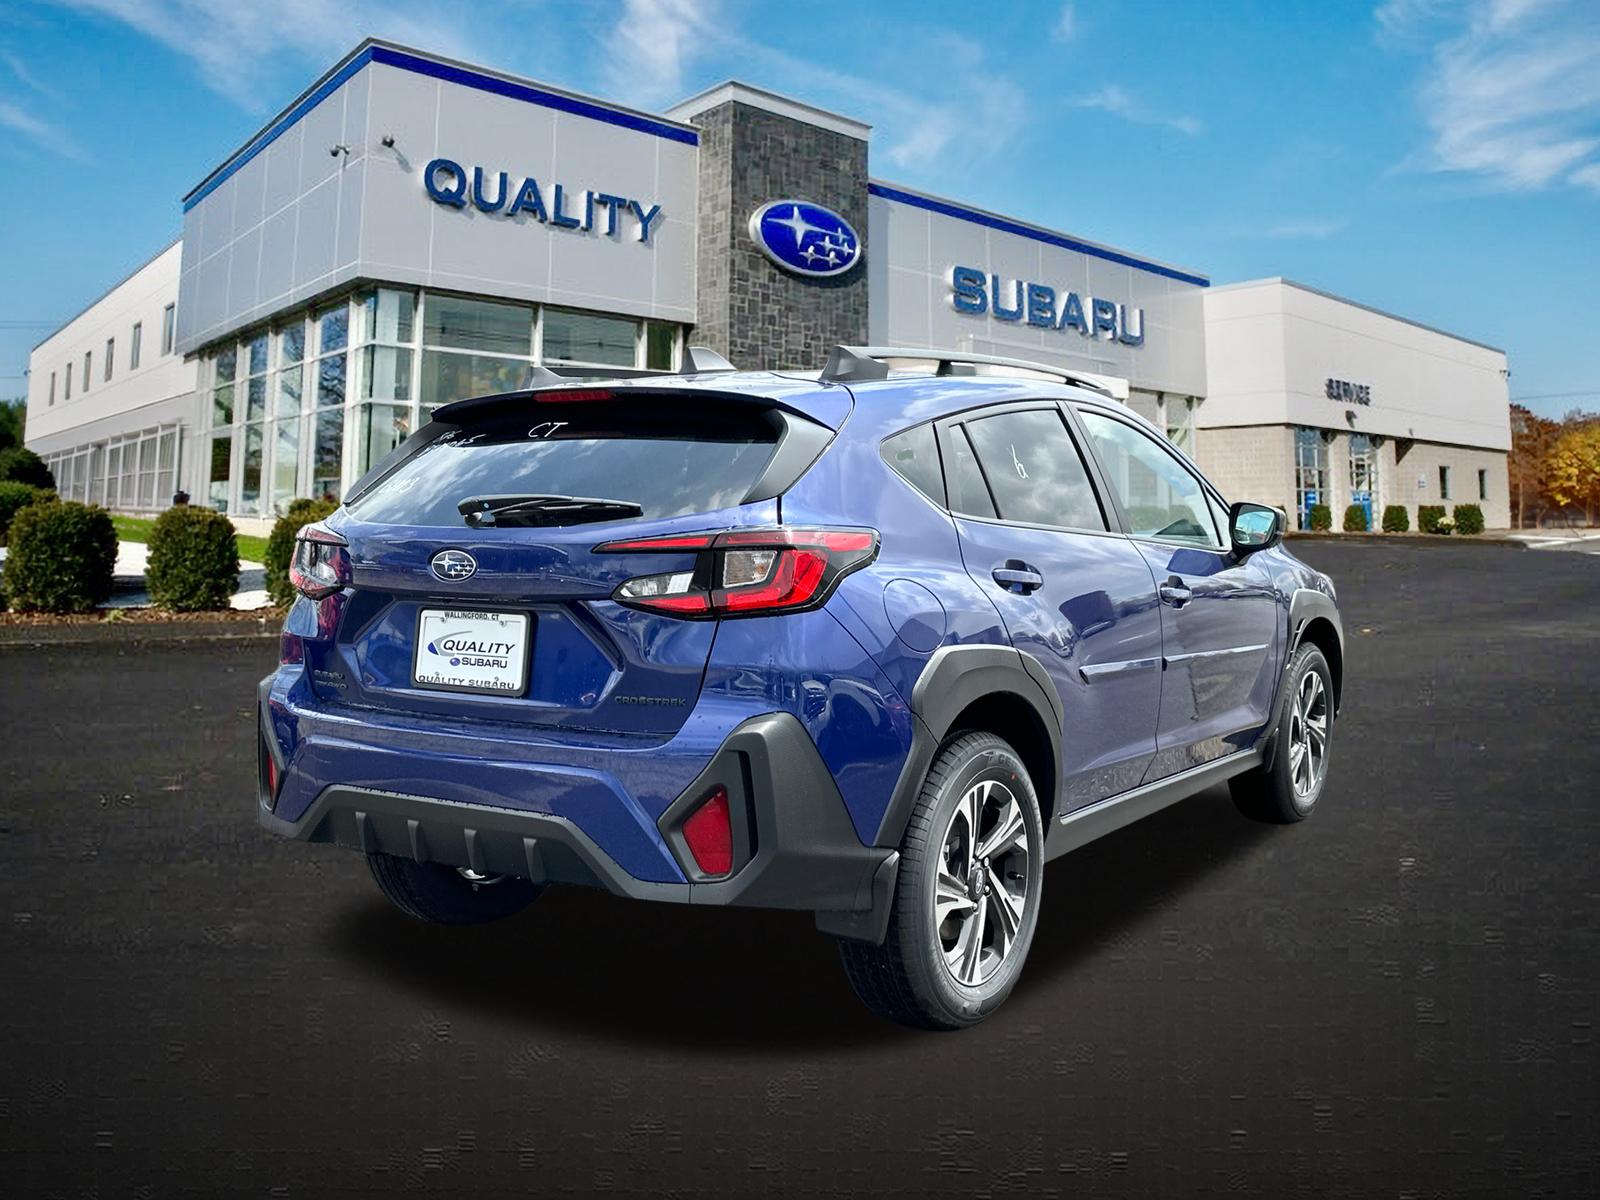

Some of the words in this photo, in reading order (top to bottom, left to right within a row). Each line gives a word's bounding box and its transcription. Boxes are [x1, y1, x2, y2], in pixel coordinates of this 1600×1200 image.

[423, 158, 662, 243] QUALITY
[951, 265, 1145, 347] SUBARU
[1326, 378, 1371, 407] SERVICE
[528, 421, 569, 438] CT
[443, 640, 515, 654] QUALITY
[462, 657, 507, 668] SUBARU
[419, 675, 465, 685] QUALITY
[469, 680, 514, 689] SUBARU
[614, 695, 686, 706] CROSSTREK
